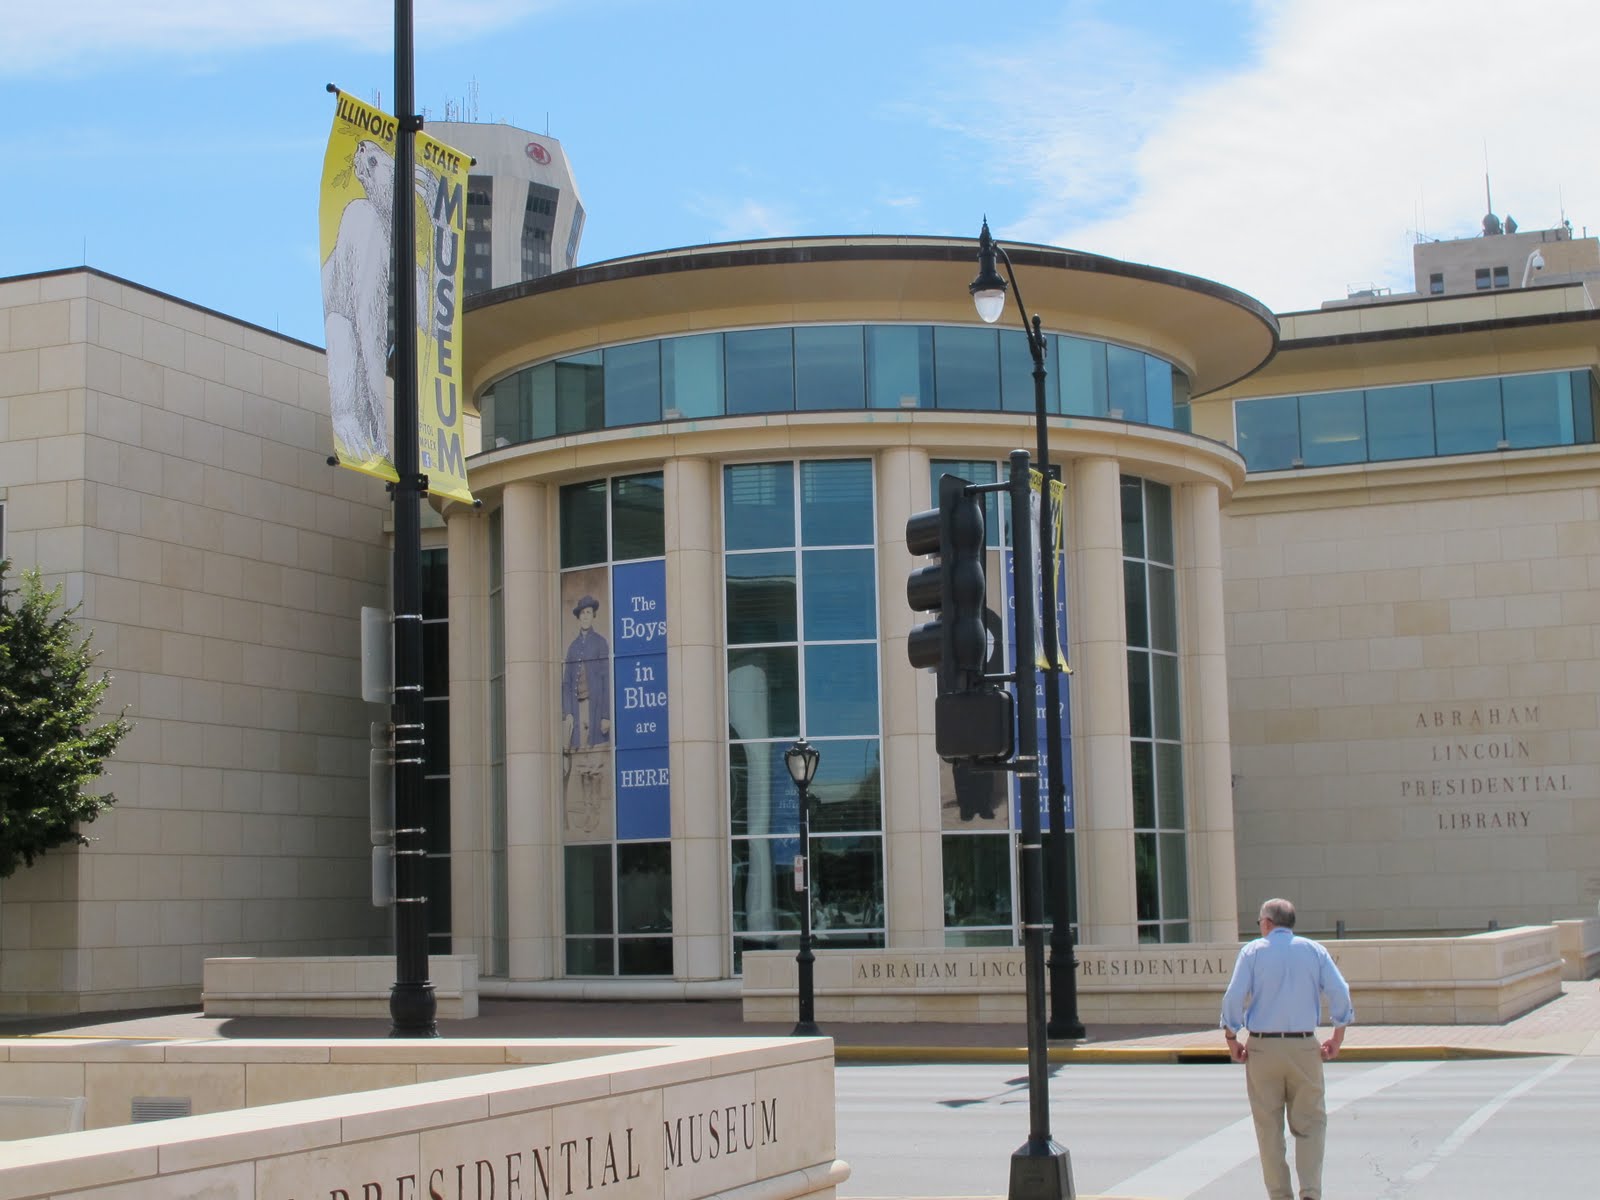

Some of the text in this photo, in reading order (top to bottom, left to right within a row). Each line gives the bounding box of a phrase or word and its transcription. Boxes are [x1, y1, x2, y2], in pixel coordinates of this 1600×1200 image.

[336, 98, 461, 175] ILLINOIS STATE
[433, 175, 467, 480] MUSEUM
[631, 596, 656, 612] The
[621, 617, 667, 641] Boys
[635, 661, 654, 682] in
[624, 686, 667, 709] Blue
[635, 720, 657, 734] are
[1416, 705, 1539, 728] ABRAHAM
[1431, 741, 1530, 762] LINCOLN
[620, 768, 669, 788] HERE
[1401, 774, 1572, 797] PRESIDENTIAL
[1438, 811, 1531, 830] LIBRARY
[857, 958, 1228, 979] ABRAHAM LINCO RESIDENTIAL
[330, 1097, 778, 1200] SIDENTIAL MUSEUM
